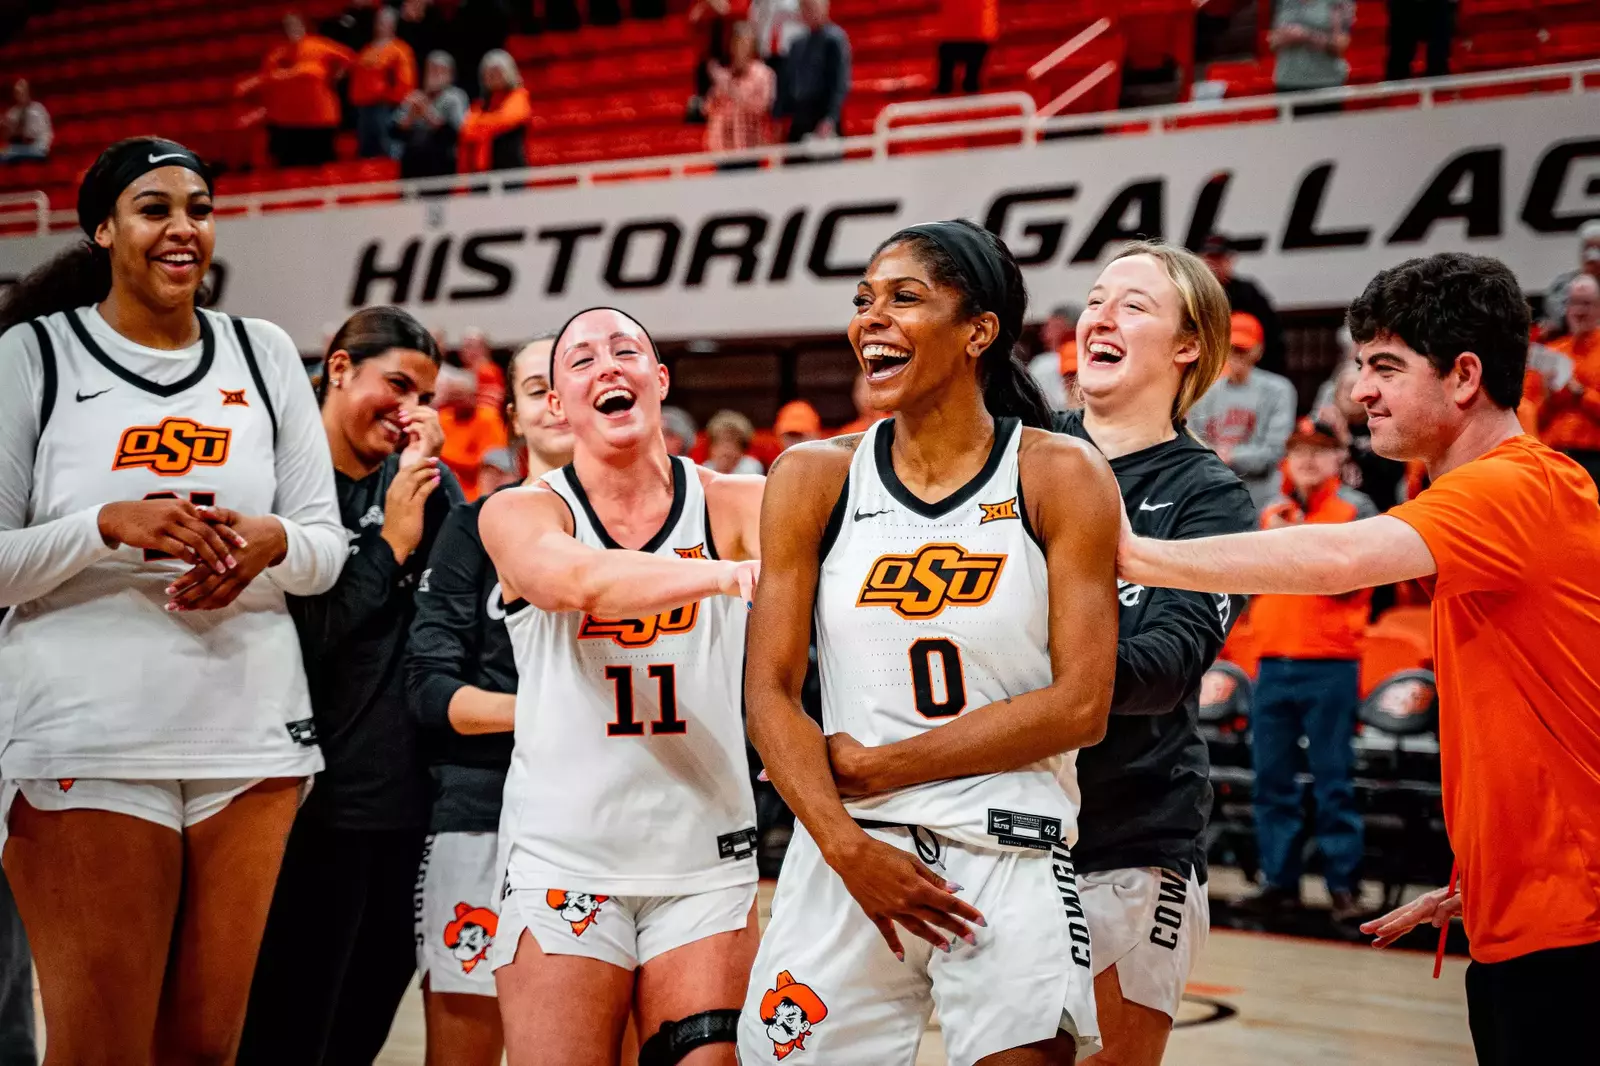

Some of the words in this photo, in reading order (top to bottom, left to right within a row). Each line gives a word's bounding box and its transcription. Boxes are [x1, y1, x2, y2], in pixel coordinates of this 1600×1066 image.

[346, 199, 902, 307] HISTORIC
[112, 416, 232, 477] OSU
[978, 496, 1021, 526] XII
[855, 542, 1009, 620] OSU
[605, 664, 687, 737] 11
[907, 636, 968, 720] 0
[1044, 824, 1058, 837] 42
[1150, 871, 1188, 951] COW
